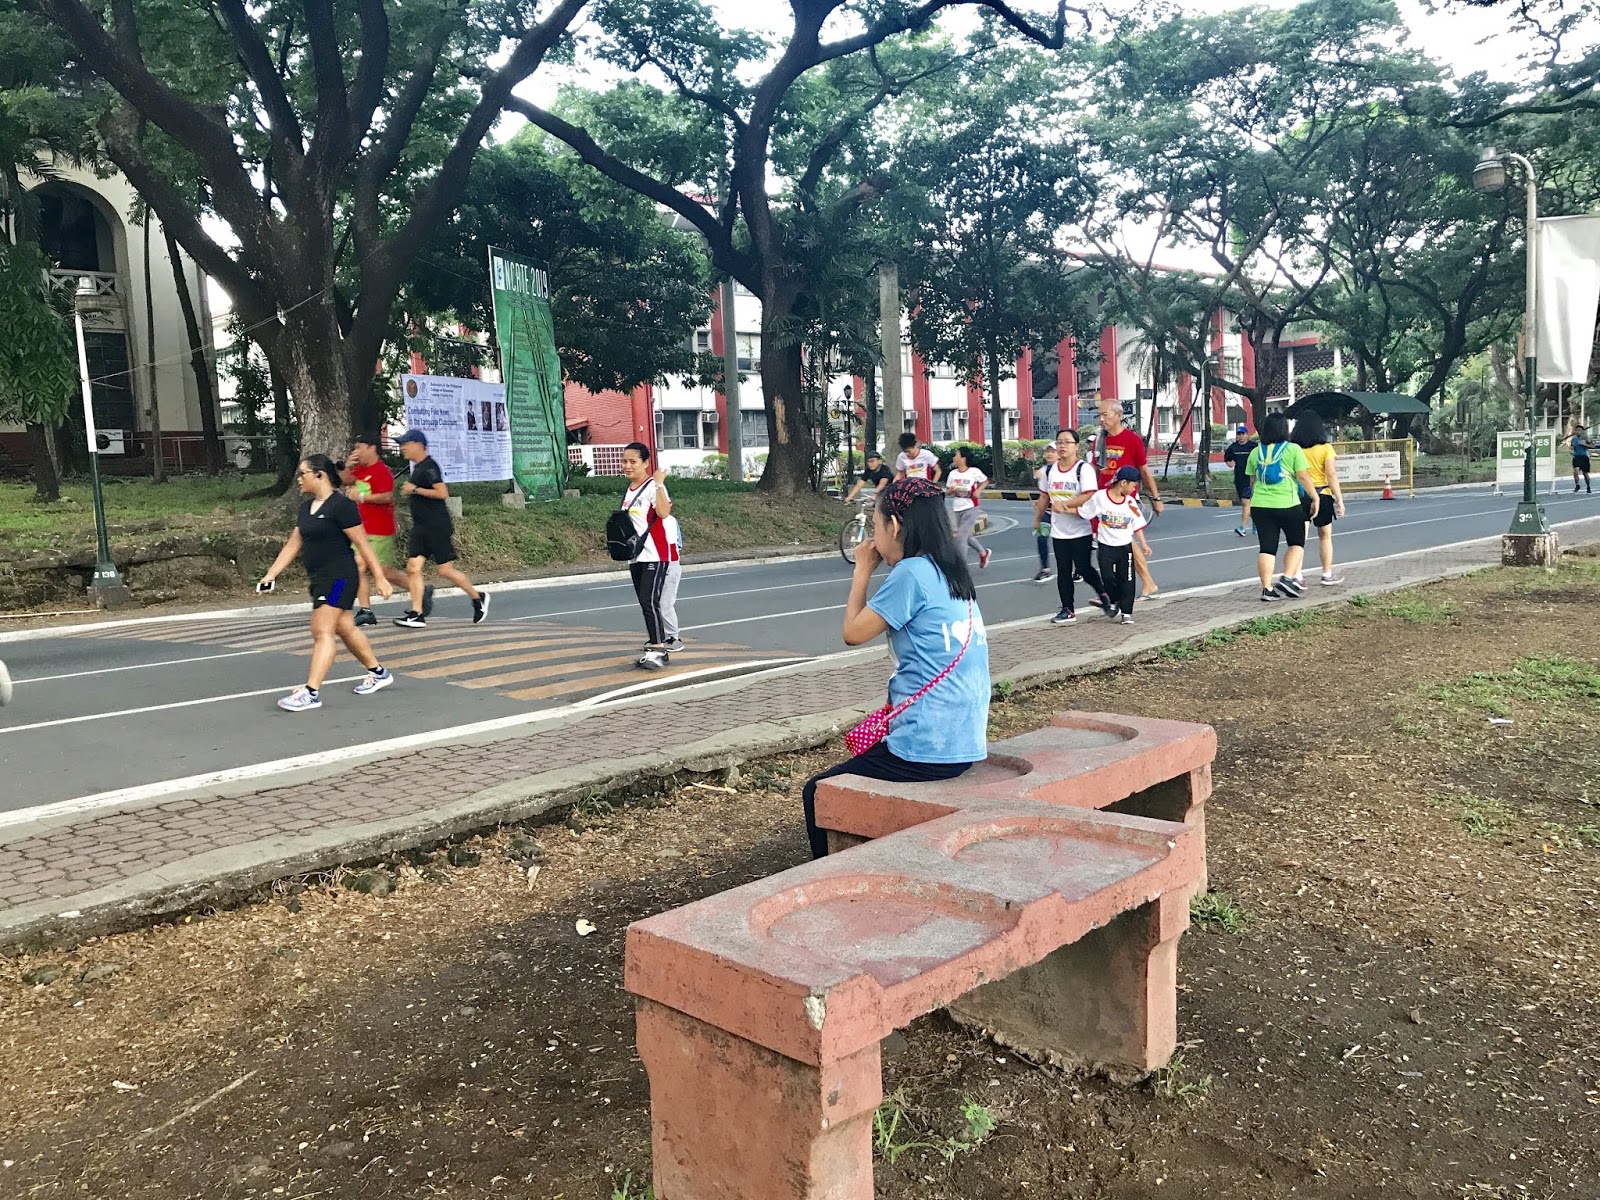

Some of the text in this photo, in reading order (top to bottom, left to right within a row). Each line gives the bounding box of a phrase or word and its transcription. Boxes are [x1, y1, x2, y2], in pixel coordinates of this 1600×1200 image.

[531, 267, 549, 299] 2019
[1502, 439, 1549, 448] BICYES
[1512, 448, 1540, 457] ONY
